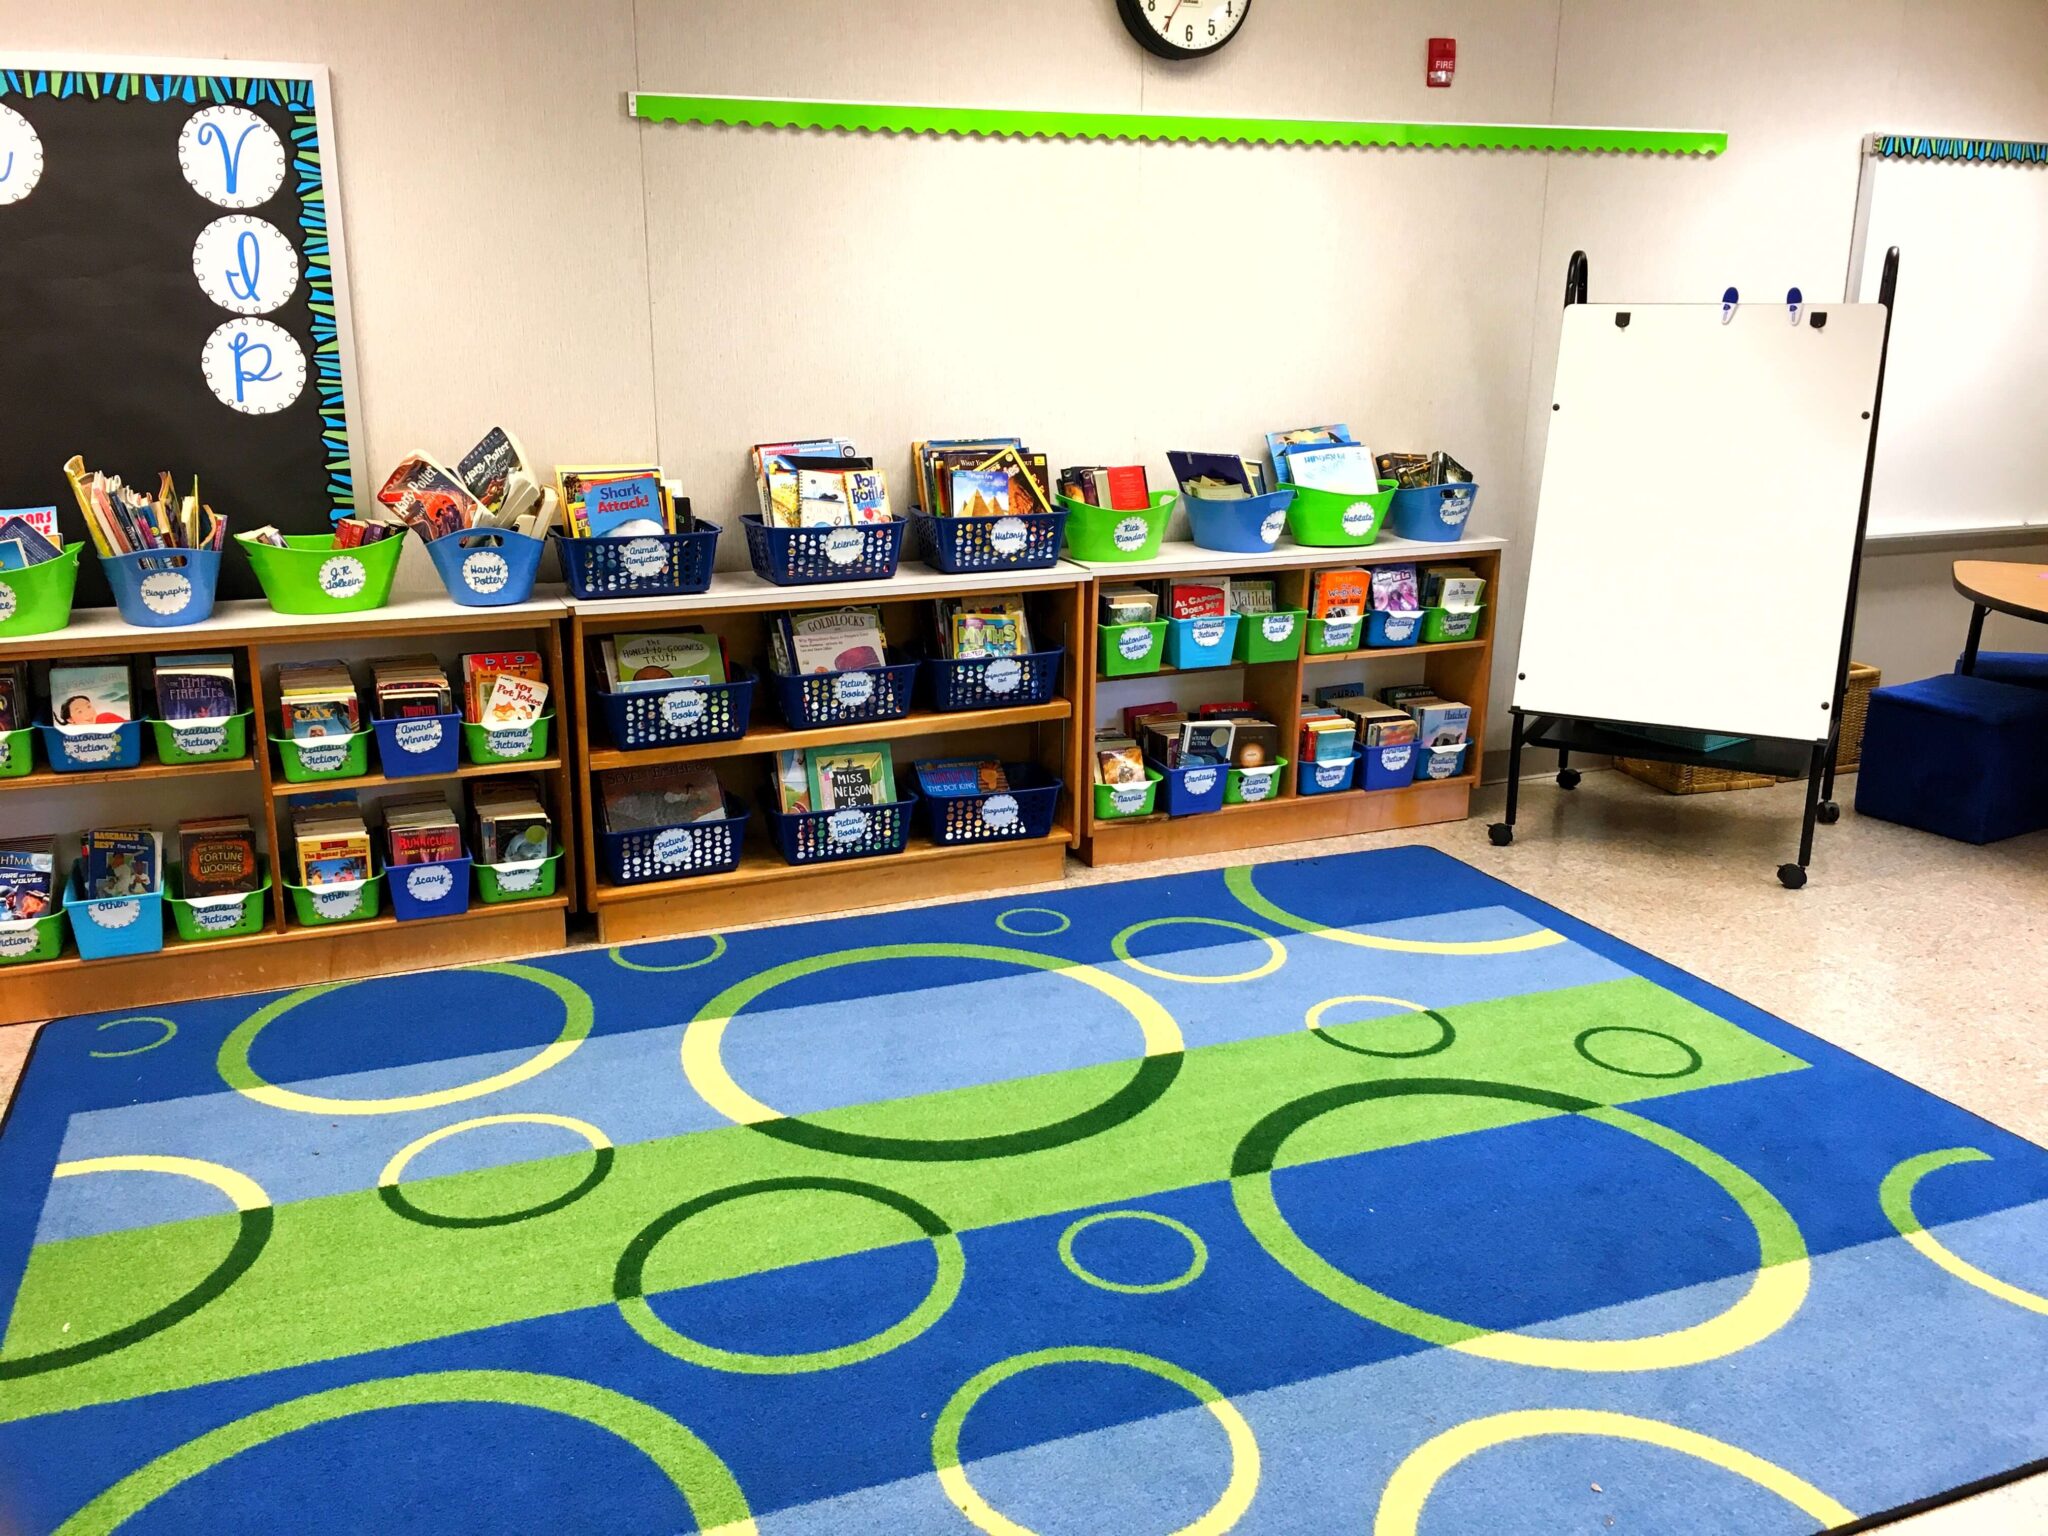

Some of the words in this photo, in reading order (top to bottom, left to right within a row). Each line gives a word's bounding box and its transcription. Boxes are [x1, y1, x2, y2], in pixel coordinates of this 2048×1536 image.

[1185, 24, 1193, 42] 6
[1208, 19, 1216, 36] 5
[1435, 60, 1454, 69] FIRE
[483, 440, 511, 464] Potter
[465, 459, 486, 486] Harry
[407, 465, 439, 492] Potter
[853, 473, 876, 490] Pop
[600, 484, 642, 501] Shark
[851, 486, 885, 504] Bottle
[393, 490, 418, 518] Harry
[597, 495, 650, 514] Attack!
[1124, 524, 1140, 533] Rick
[994, 530, 1026, 543] History
[1116, 532, 1146, 542] Riordan
[831, 539, 860, 550] Science
[629, 545, 658, 556] Animal
[625, 552, 667, 566] Nonfiction
[470, 563, 502, 576] Harry
[473, 575, 505, 586] Potter
[145, 587, 189, 599] Biography
[1232, 591, 1271, 606] Matilda
[807, 614, 865, 632] GOLDILOCKS
[958, 624, 1017, 645] MYTHS
[1120, 632, 1151, 645] Historical
[1126, 644, 1147, 654] Fiction
[180, 677, 207, 688] TIME
[839, 680, 868, 690] Picture
[169, 688, 225, 700] FIREFLIES
[513, 691, 543, 706] Jokes
[840, 690, 866, 699] Books
[667, 700, 699, 709] Picture
[671, 711, 699, 721] Books
[401, 722, 434, 734] Award
[492, 729, 529, 738] Animal
[181, 738, 218, 748] Fiction
[400, 733, 441, 746] Winners
[493, 739, 526, 750] Fiction
[73, 743, 110, 754] Fiction
[307, 754, 342, 765] Fiction
[837, 773, 863, 783] MISS
[1187, 774, 1216, 783] Fantasy
[834, 785, 872, 798] NELSON
[1245, 787, 1266, 795] Fiction
[848, 797, 857, 806] IS
[1117, 794, 1142, 803] Narnia
[983, 807, 1015, 815] Biography
[835, 817, 863, 828] Picture
[94, 832, 139, 841] BASEBALL'S
[837, 827, 862, 837] Books
[656, 835, 687, 850] Picture
[199, 852, 243, 863] FORTUNE
[661, 846, 689, 859] Books
[200, 863, 242, 874] WOOKIEE
[414, 874, 446, 887] Scary
[201, 914, 237, 924] Fiction
[0, 937, 32, 947] iction
